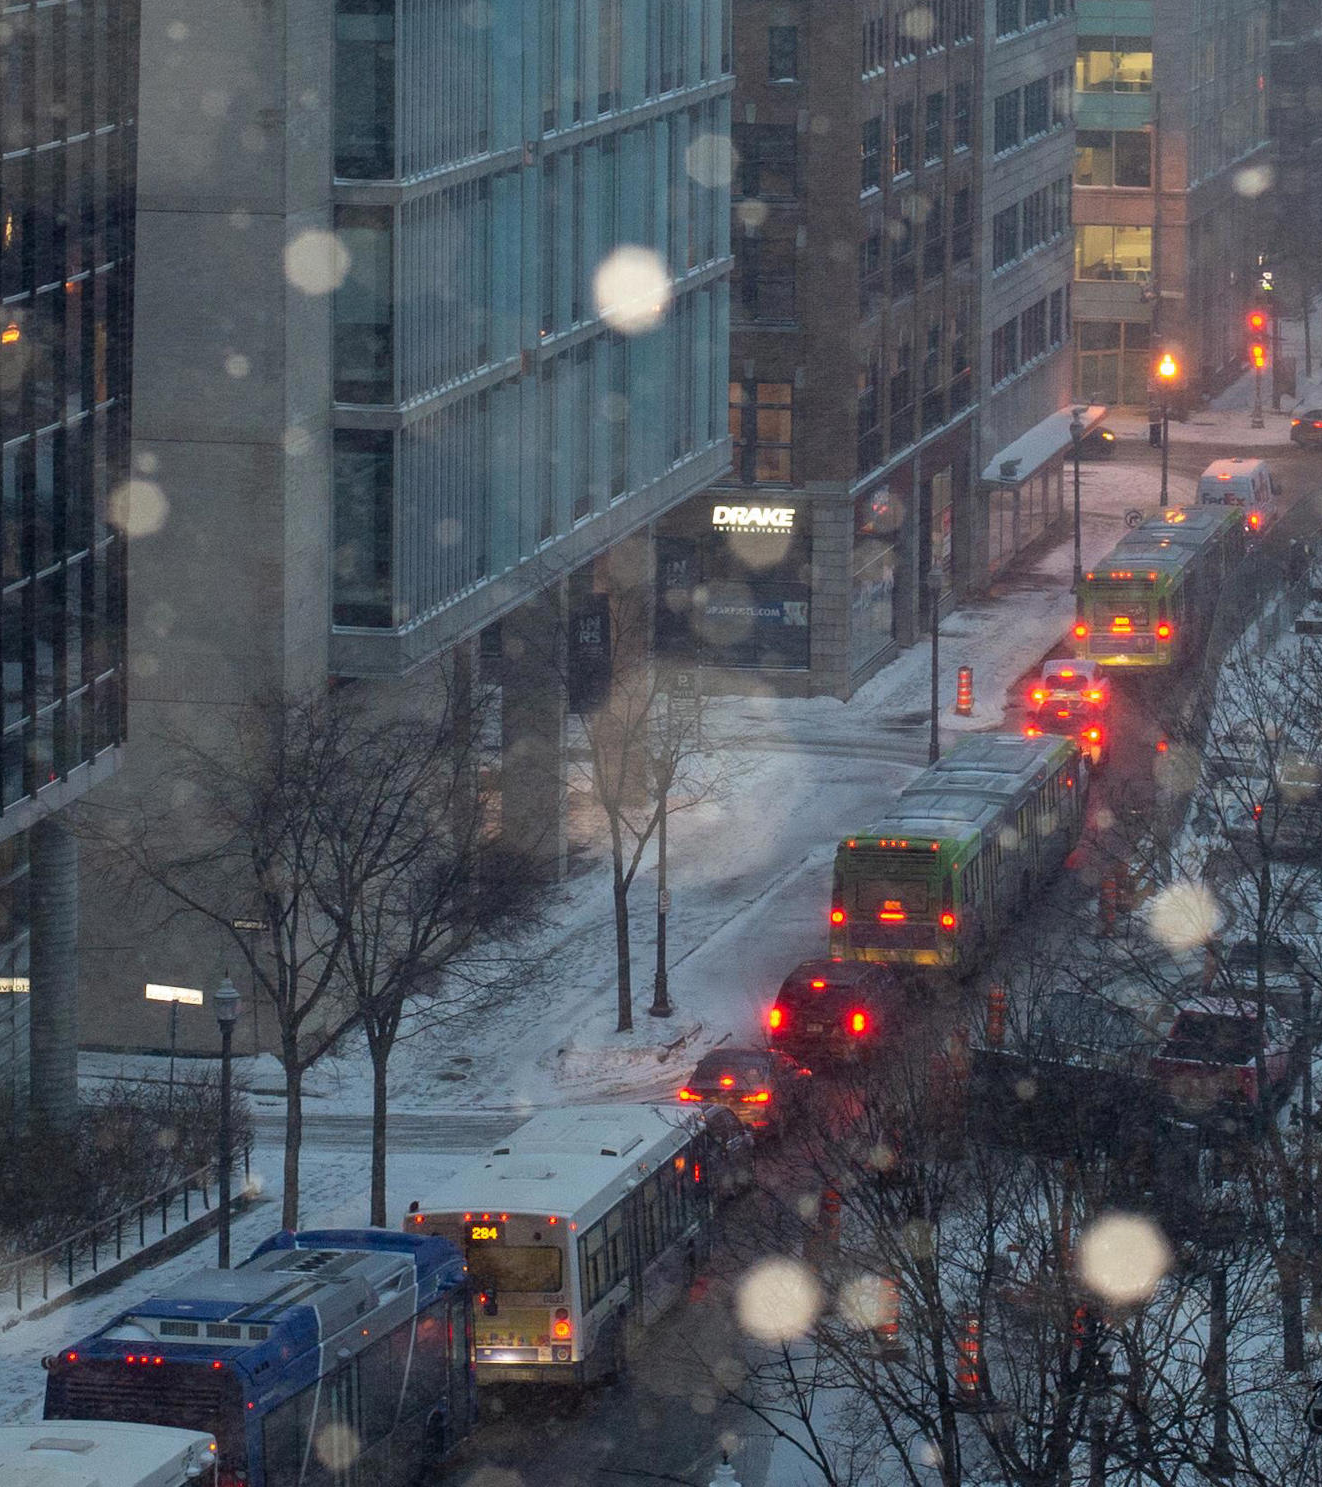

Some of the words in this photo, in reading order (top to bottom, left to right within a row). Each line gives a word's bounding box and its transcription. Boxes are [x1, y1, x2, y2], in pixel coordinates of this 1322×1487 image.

[712, 506, 796, 526] DRAKE
[713, 526, 791, 534] INTERNATIONAL
[472, 1227, 498, 1240] 284
